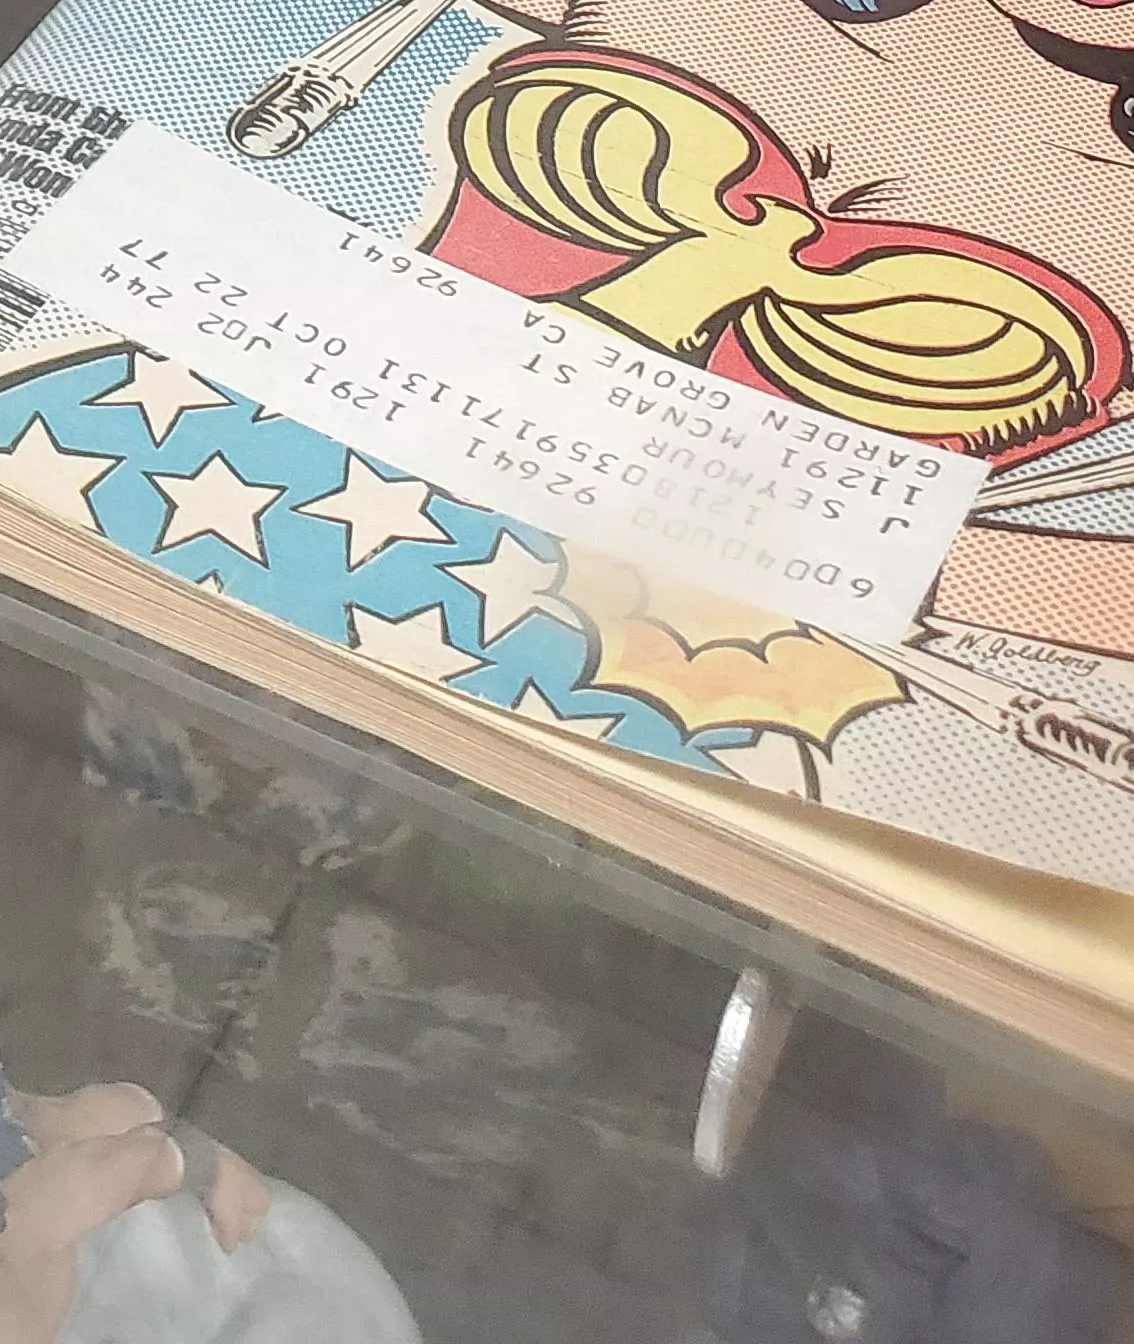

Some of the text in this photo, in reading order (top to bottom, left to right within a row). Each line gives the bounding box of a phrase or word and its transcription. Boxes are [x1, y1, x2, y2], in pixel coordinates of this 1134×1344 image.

[118, 238, 170, 271] 77
[99, 262, 174, 309] 244
[193, 271, 249, 308] 22
[266, 311, 348, 358] OCT
[338, 230, 942, 480] GARDEN GROVE CA 92641
[303, 362, 408, 424] 1291
[518, 353, 925, 507] 11291 MCNAB ST
[464, 436, 599, 506] 92641
[641, 435, 911, 535] J SEYMOUR
[982, 637, 1102, 677] Goldberg
